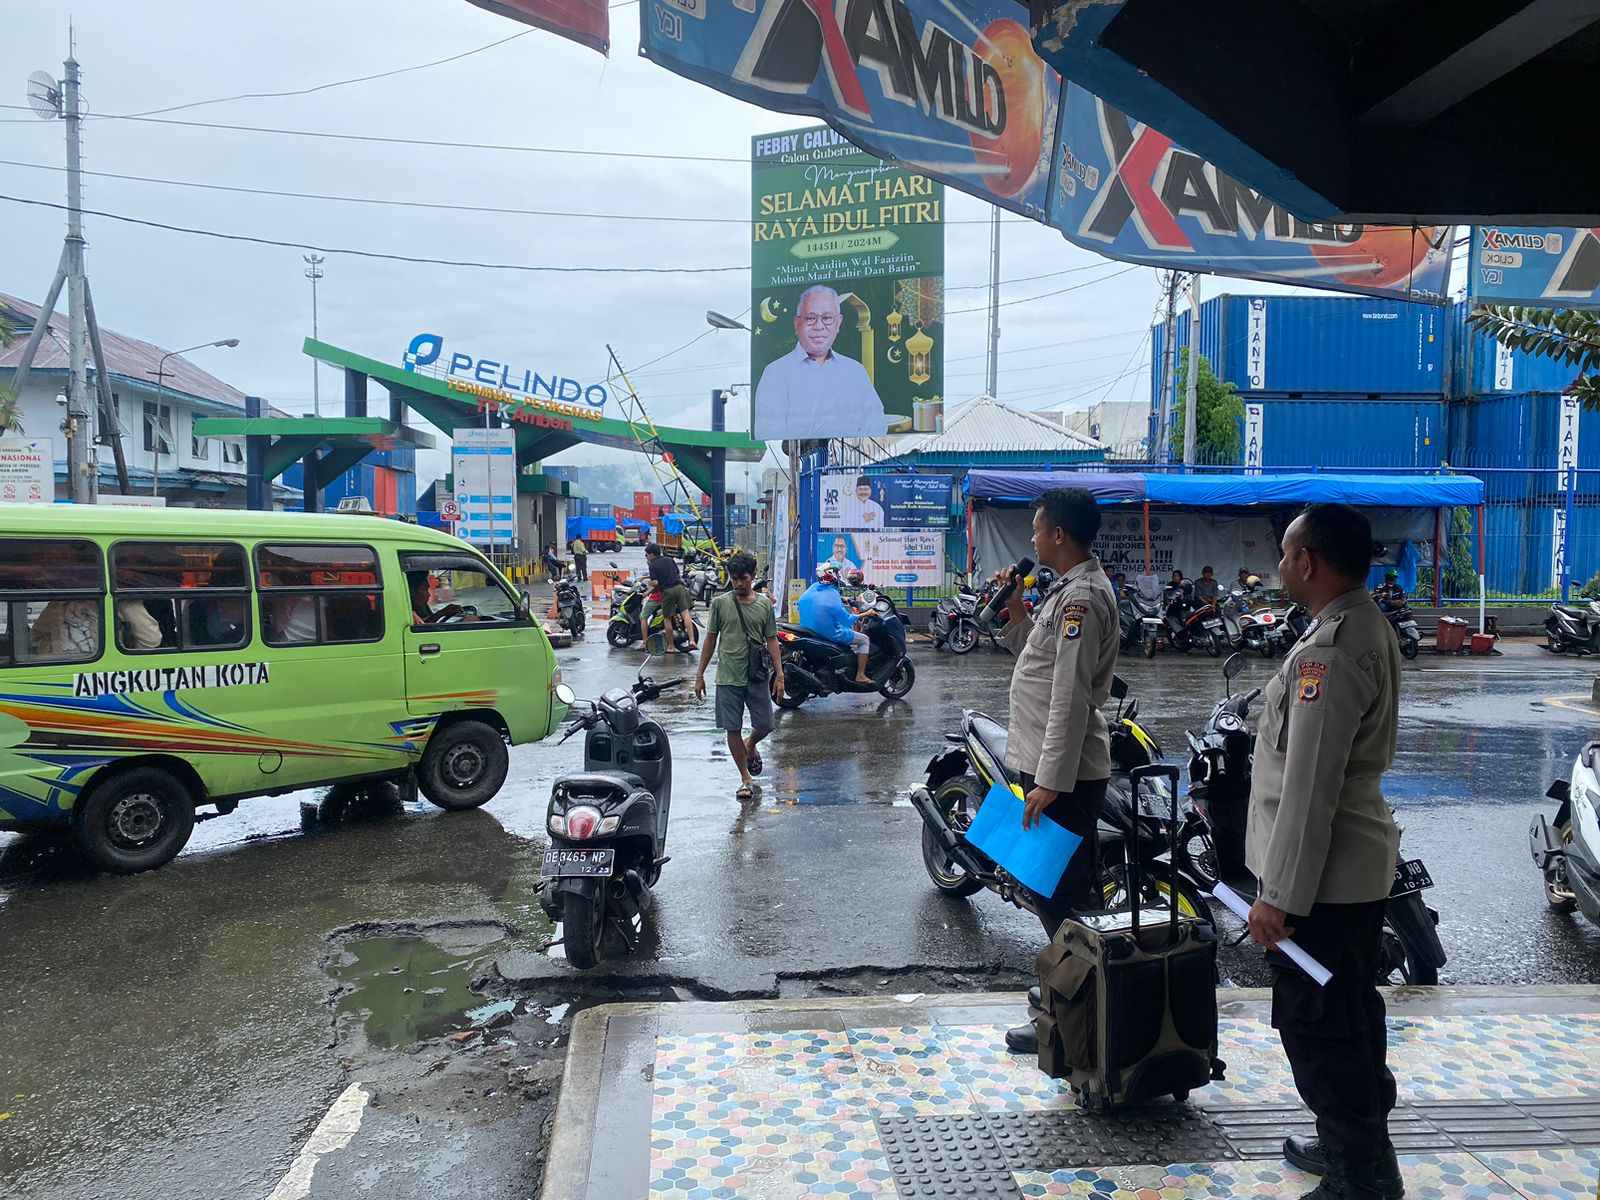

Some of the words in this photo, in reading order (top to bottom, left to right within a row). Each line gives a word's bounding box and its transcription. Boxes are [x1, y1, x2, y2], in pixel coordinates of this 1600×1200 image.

[756, 134, 799, 157] FEBRY
[781, 152, 810, 164] Calon
[760, 182, 871, 216] SELAMAT
[874, 174, 934, 201] HARI
[754, 215, 818, 242] RAYA
[822, 208, 875, 234] IDUL
[879, 200, 940, 227] FITRI
[807, 241, 838, 253] 1445H
[847, 236, 882, 249] 2024M
[770, 273, 805, 286] Mohon
[808, 269, 833, 282] Maaf
[834, 266, 862, 279] Lahir
[865, 264, 886, 276] Dan
[851, 256, 871, 267] Wal
[1251, 317, 1261, 386] TANTO
[450, 352, 608, 407] PELINDO
[447, 379, 516, 404] TERMINAL
[523, 395, 601, 423] PETIKEMAS
[512, 405, 574, 432] Ambon
[75, 666, 206, 697] ANGKUTAN
[216, 662, 270, 687] KOTA
[545, 852, 558, 863] DE
[559, 851, 587, 862] 3465
[592, 852, 606, 863] NP
